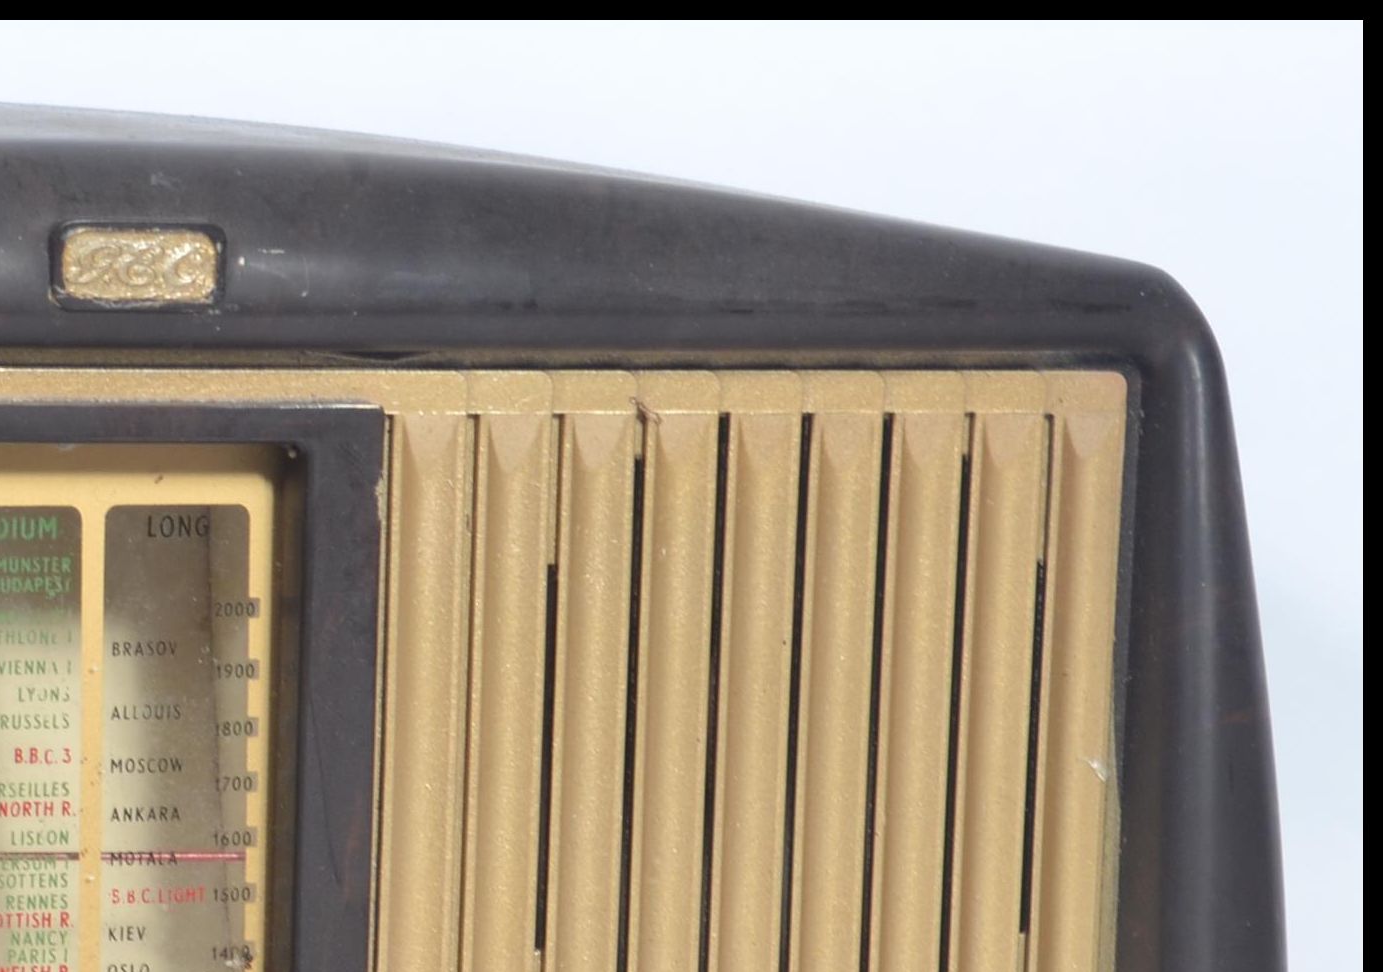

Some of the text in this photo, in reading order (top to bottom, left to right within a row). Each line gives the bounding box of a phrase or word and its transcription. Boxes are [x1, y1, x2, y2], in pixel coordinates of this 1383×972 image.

[147, 515, 211, 538] LONG
[215, 601, 256, 618] 2000
[111, 640, 178, 657] BRASOV
[217, 663, 255, 679] 1900
[110, 704, 183, 721] ALLOUIS
[215, 720, 254, 737] 1800
[62, 747, 72, 764] 3
[110, 757, 183, 774] MOSCOW
[216, 776, 253, 792] 1700
[110, 806, 181, 823] ANKARA
[214, 830, 253, 847] 1600
[110, 851, 178, 867] MOTALA
[5, 893, 69, 911] RENNES
[213, 886, 251, 903] 1500
[11, 930, 68, 947] NANCY
[108, 925, 147, 942] KIEV
[7, 949, 57, 965] PARIS
